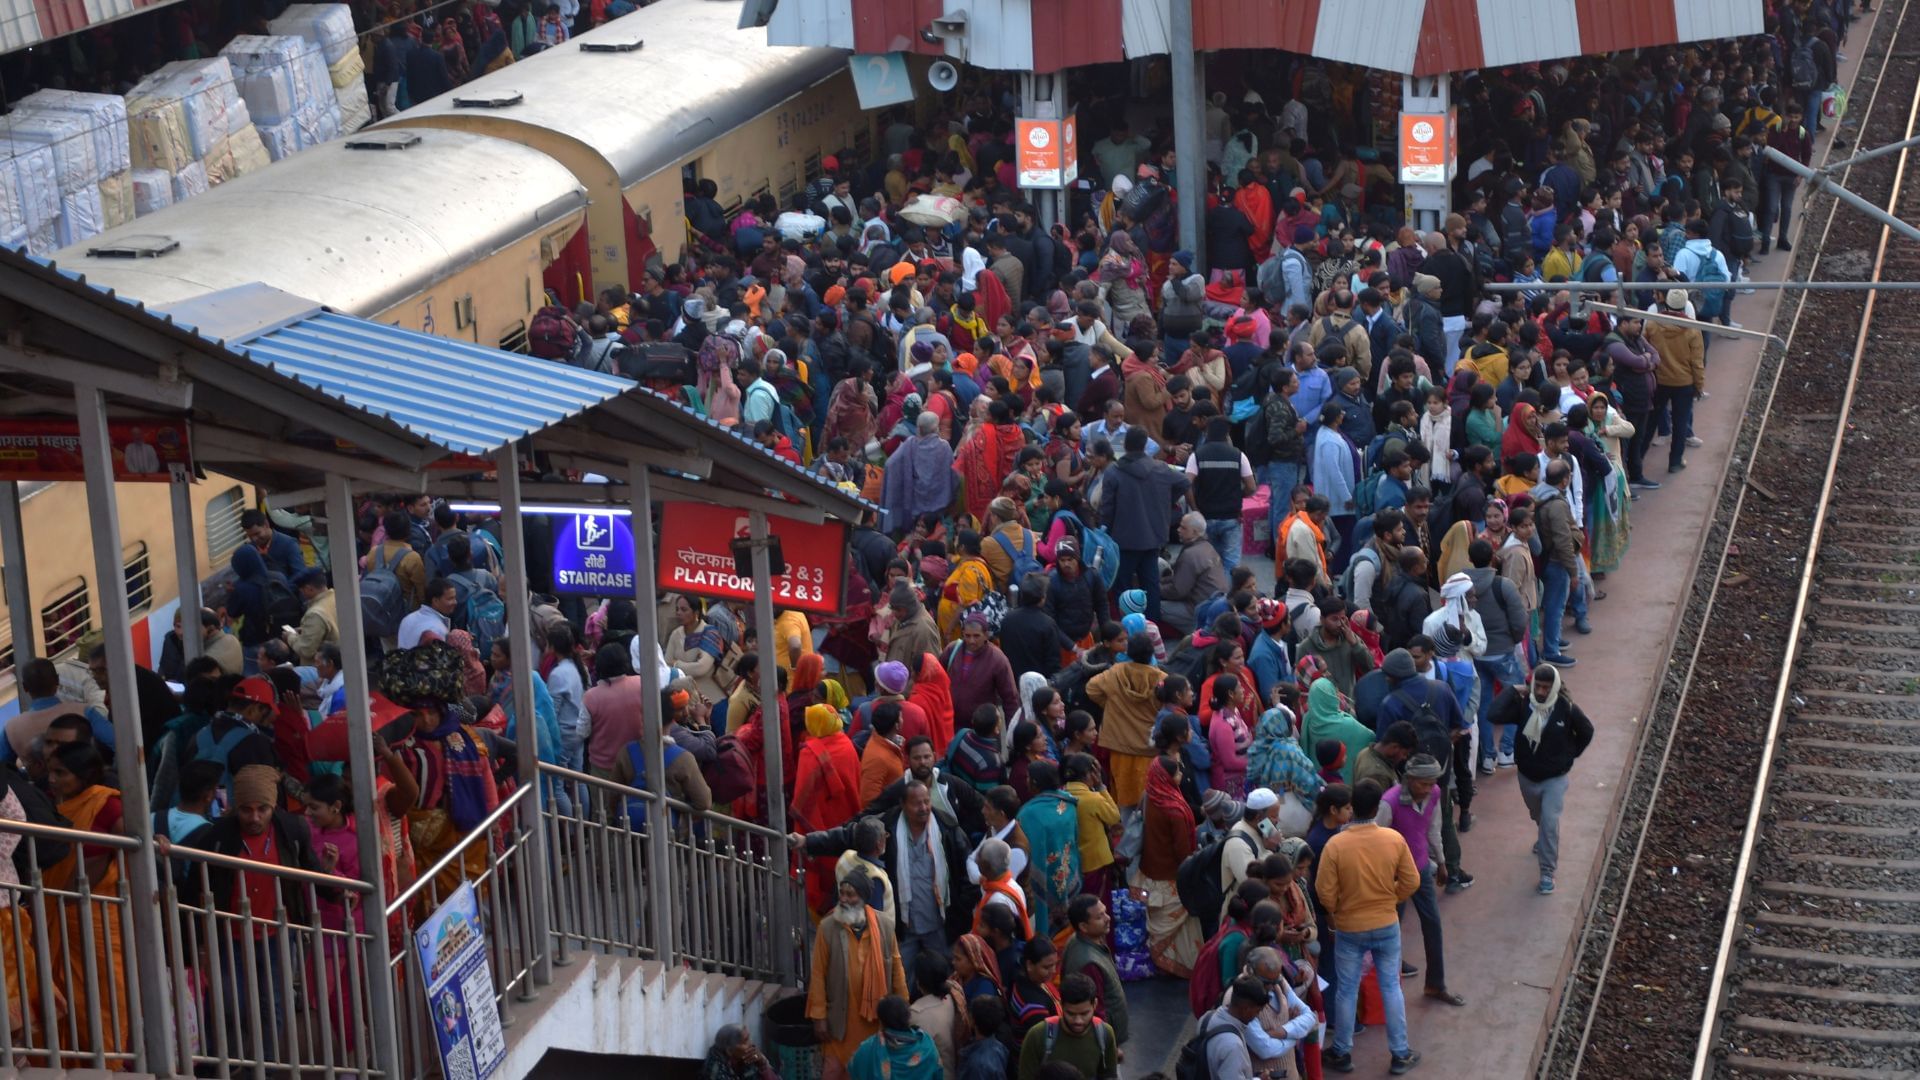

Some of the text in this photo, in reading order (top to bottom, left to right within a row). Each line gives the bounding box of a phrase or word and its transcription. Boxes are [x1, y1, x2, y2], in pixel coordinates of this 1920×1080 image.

[867, 56, 897, 96] 2
[0, 435, 38, 448] ागराज
[175, 471, 186, 482] 24
[559, 569, 632, 588] STAIRCASE
[674, 566, 755, 593] PLATFOR
[779, 580, 791, 597] 2
[795, 584, 808, 600] &
[811, 585, 823, 602] 3
[796, 566, 809, 581] &
[813, 567, 824, 584] 3
